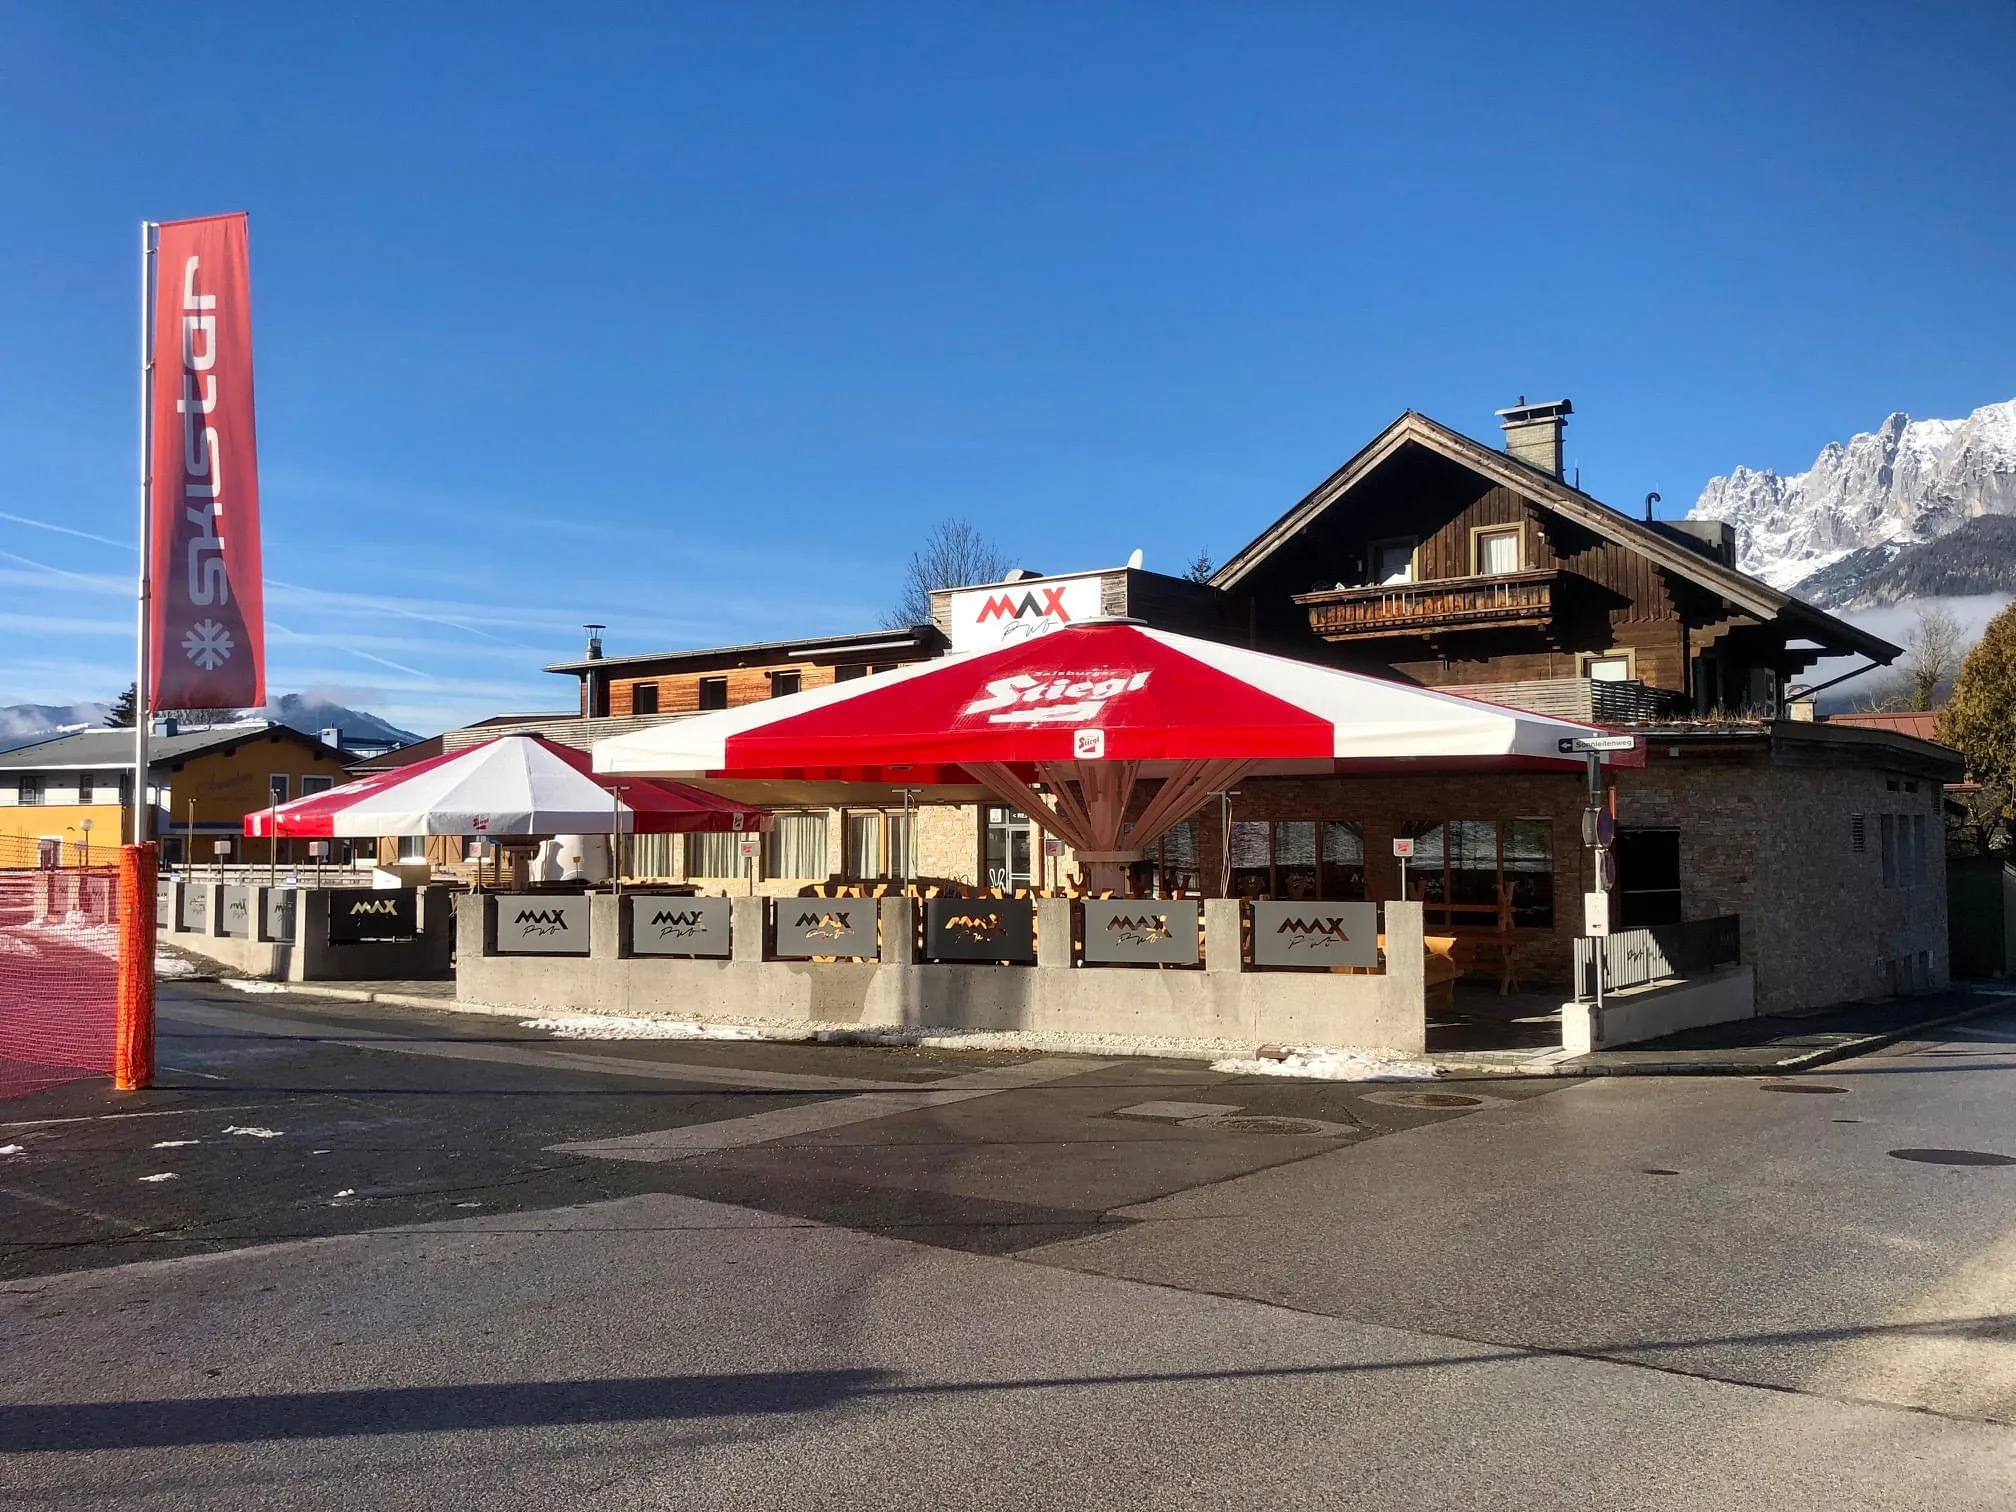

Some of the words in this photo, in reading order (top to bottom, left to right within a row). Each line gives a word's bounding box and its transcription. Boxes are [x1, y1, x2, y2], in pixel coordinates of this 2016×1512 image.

[177, 256, 229, 607] skistar
[976, 587, 1071, 624] MAX
[964, 671, 1153, 715] Stiegl
[1575, 739, 1632, 749] Sonnleitenweg
[350, 900, 398, 915] MAX
[514, 909, 568, 930] MAX
[795, 912, 853, 930] MAX
[1105, 915, 1173, 938] MAX
[1277, 917, 1350, 941] MAX
